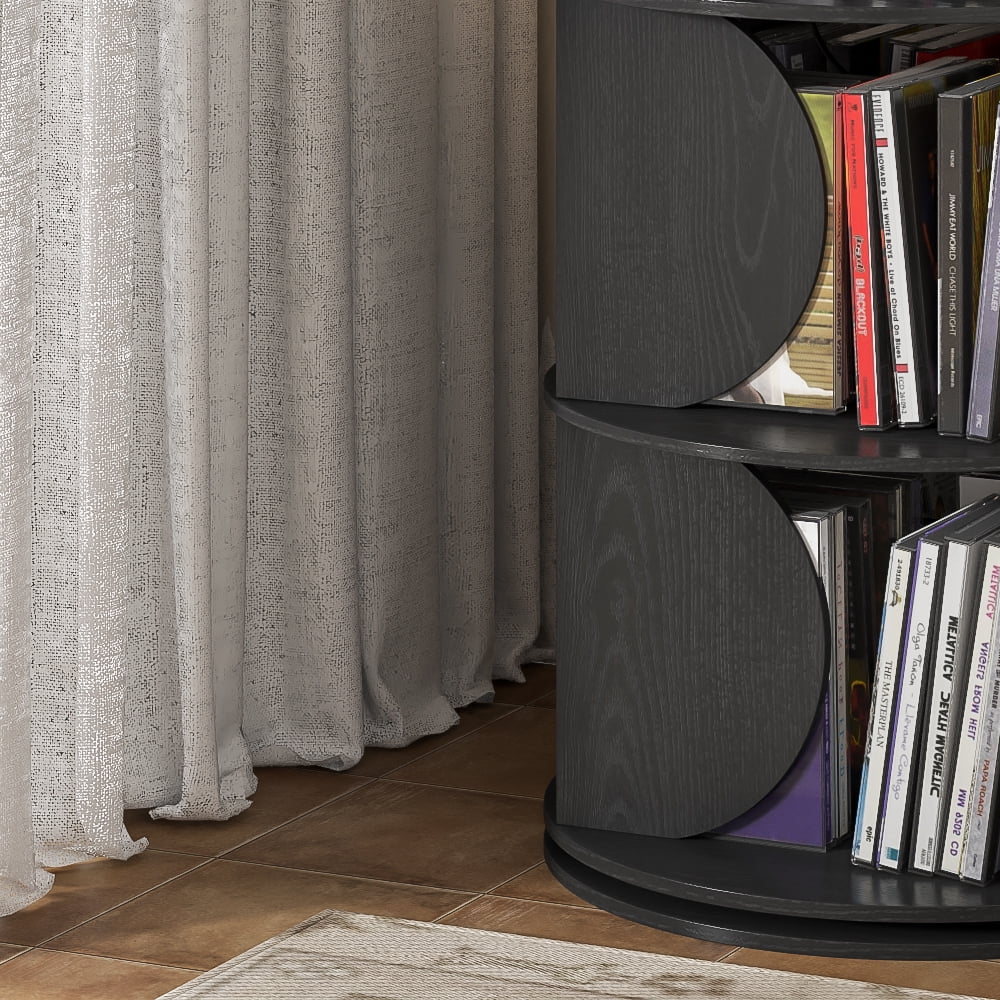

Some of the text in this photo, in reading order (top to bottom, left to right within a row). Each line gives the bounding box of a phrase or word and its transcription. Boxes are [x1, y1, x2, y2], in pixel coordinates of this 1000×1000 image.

[871, 94, 885, 133] EVIDENCE
[878, 152, 886, 187] HOWARD
[948, 193, 956, 218] JIMMY
[883, 213, 891, 237] WHITE
[885, 239, 893, 259] BOYS
[948, 232, 956, 261] WORLD
[888, 269, 896, 285] Live
[993, 268, 1000, 285] UNA
[890, 287, 897, 296] at
[990, 286, 1000, 312] MUJER
[855, 278, 868, 337] BLACKOUT
[891, 298, 899, 322] Chord
[893, 324, 900, 336] On
[922, 557, 933, 586] 18733-2
[911, 622, 926, 651] Olga
[875, 660, 893, 748] THE MASTERPLAN
[991, 679, 1000, 708] MURDER
[891, 754, 910, 801] Contigo
[981, 759, 990, 783] PAPA
[976, 785, 986, 817] ROACH
[865, 825, 874, 843] epic
